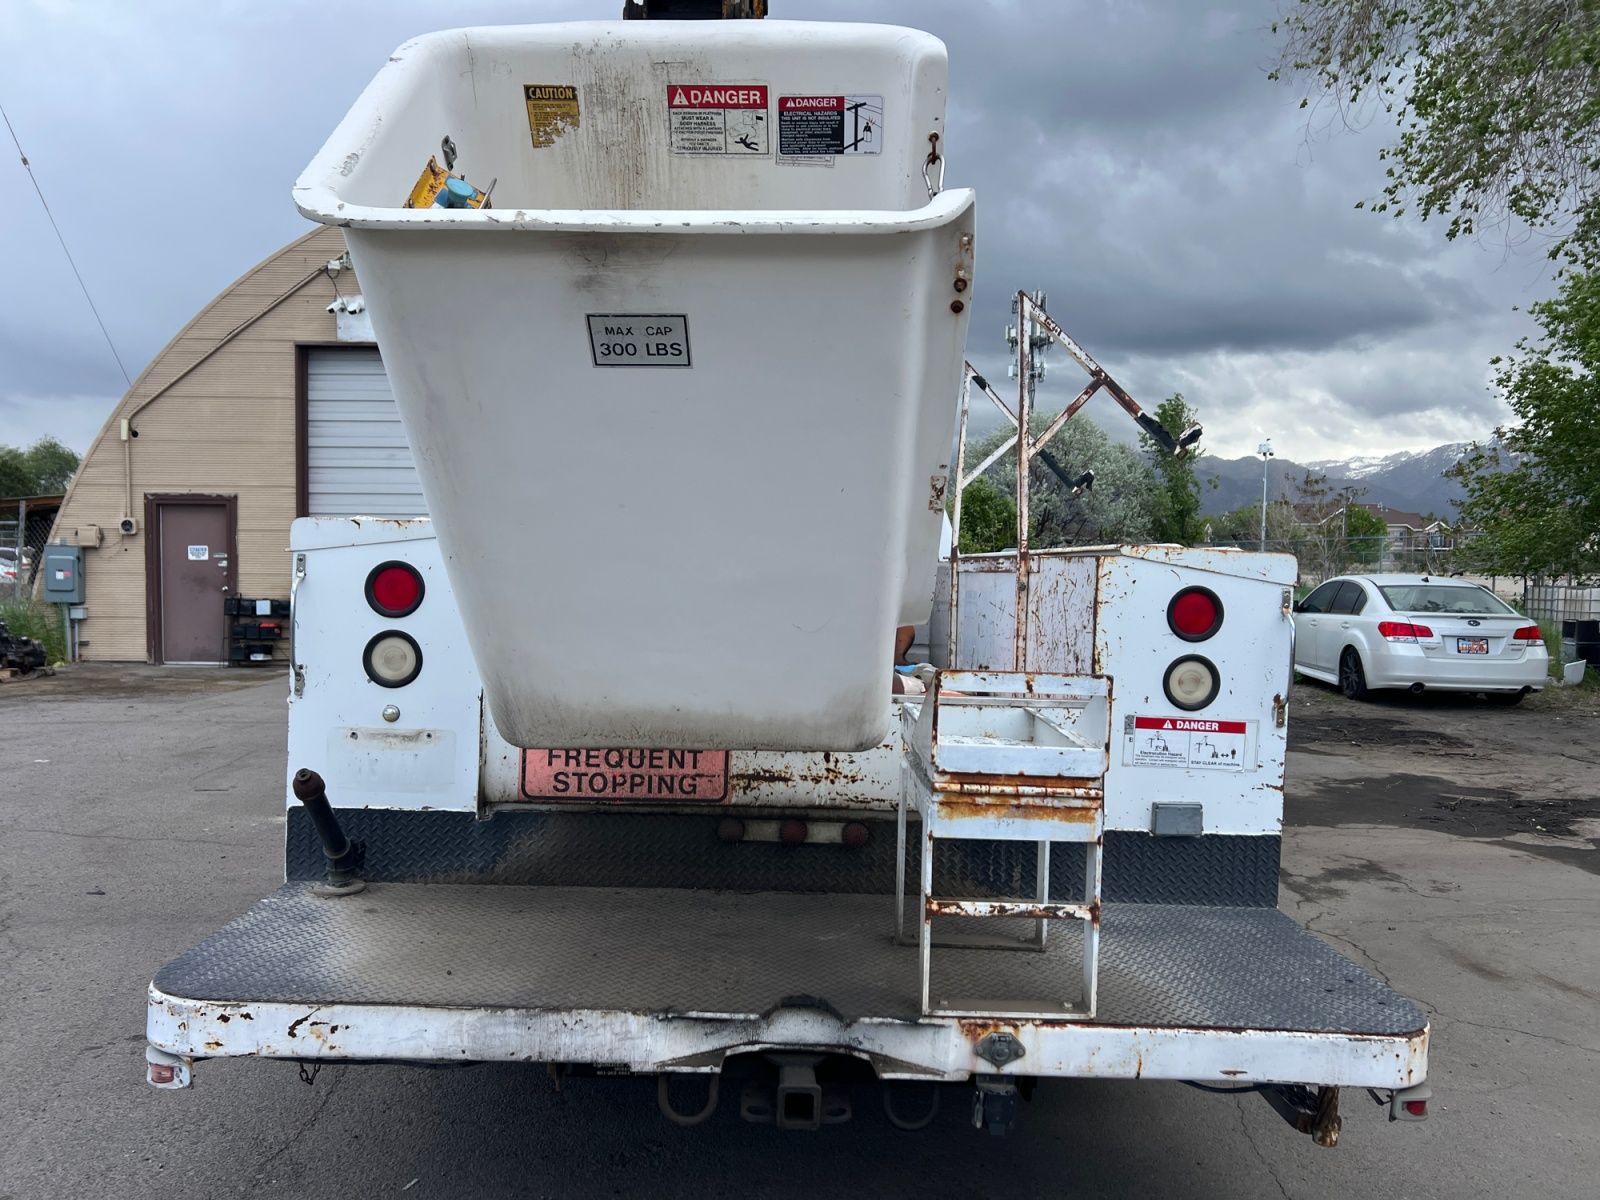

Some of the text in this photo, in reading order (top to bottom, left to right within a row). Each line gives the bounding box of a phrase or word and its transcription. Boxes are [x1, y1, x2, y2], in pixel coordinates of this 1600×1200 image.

[529, 87, 573, 99] CAUTION
[690, 90, 761, 104] DANGER
[795, 98, 837, 107] DANGER
[604, 326, 672, 336] MAX CAP
[600, 342, 683, 357] 300 LBS
[1176, 720, 1219, 731] DANGER
[547, 749, 703, 769] FREQUENT
[552, 771, 698, 795] STOPPING
